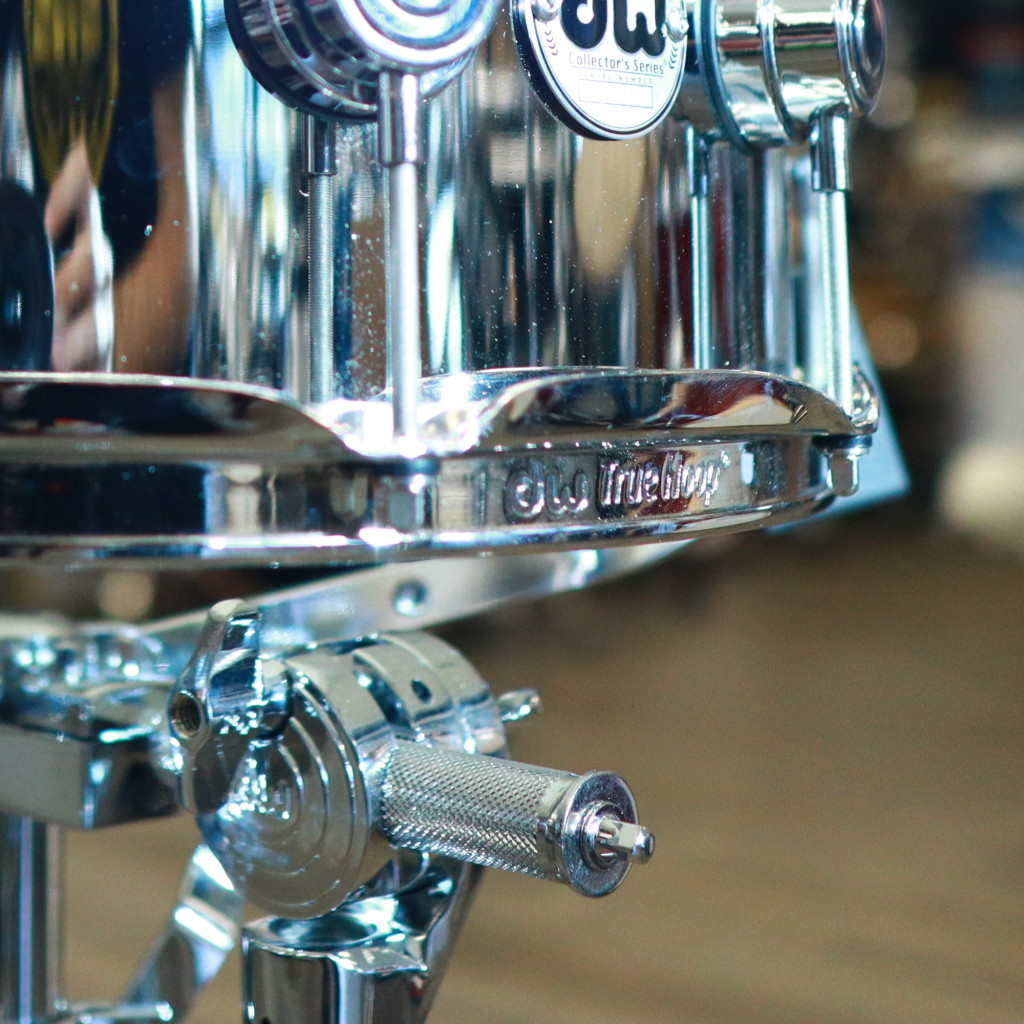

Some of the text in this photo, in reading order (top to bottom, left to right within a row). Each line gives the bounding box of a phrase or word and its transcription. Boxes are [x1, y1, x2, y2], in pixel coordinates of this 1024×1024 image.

[569, 52, 664, 75] Collector's Series
[504, 460, 592, 520] dw
[598, 456, 659, 506] True
